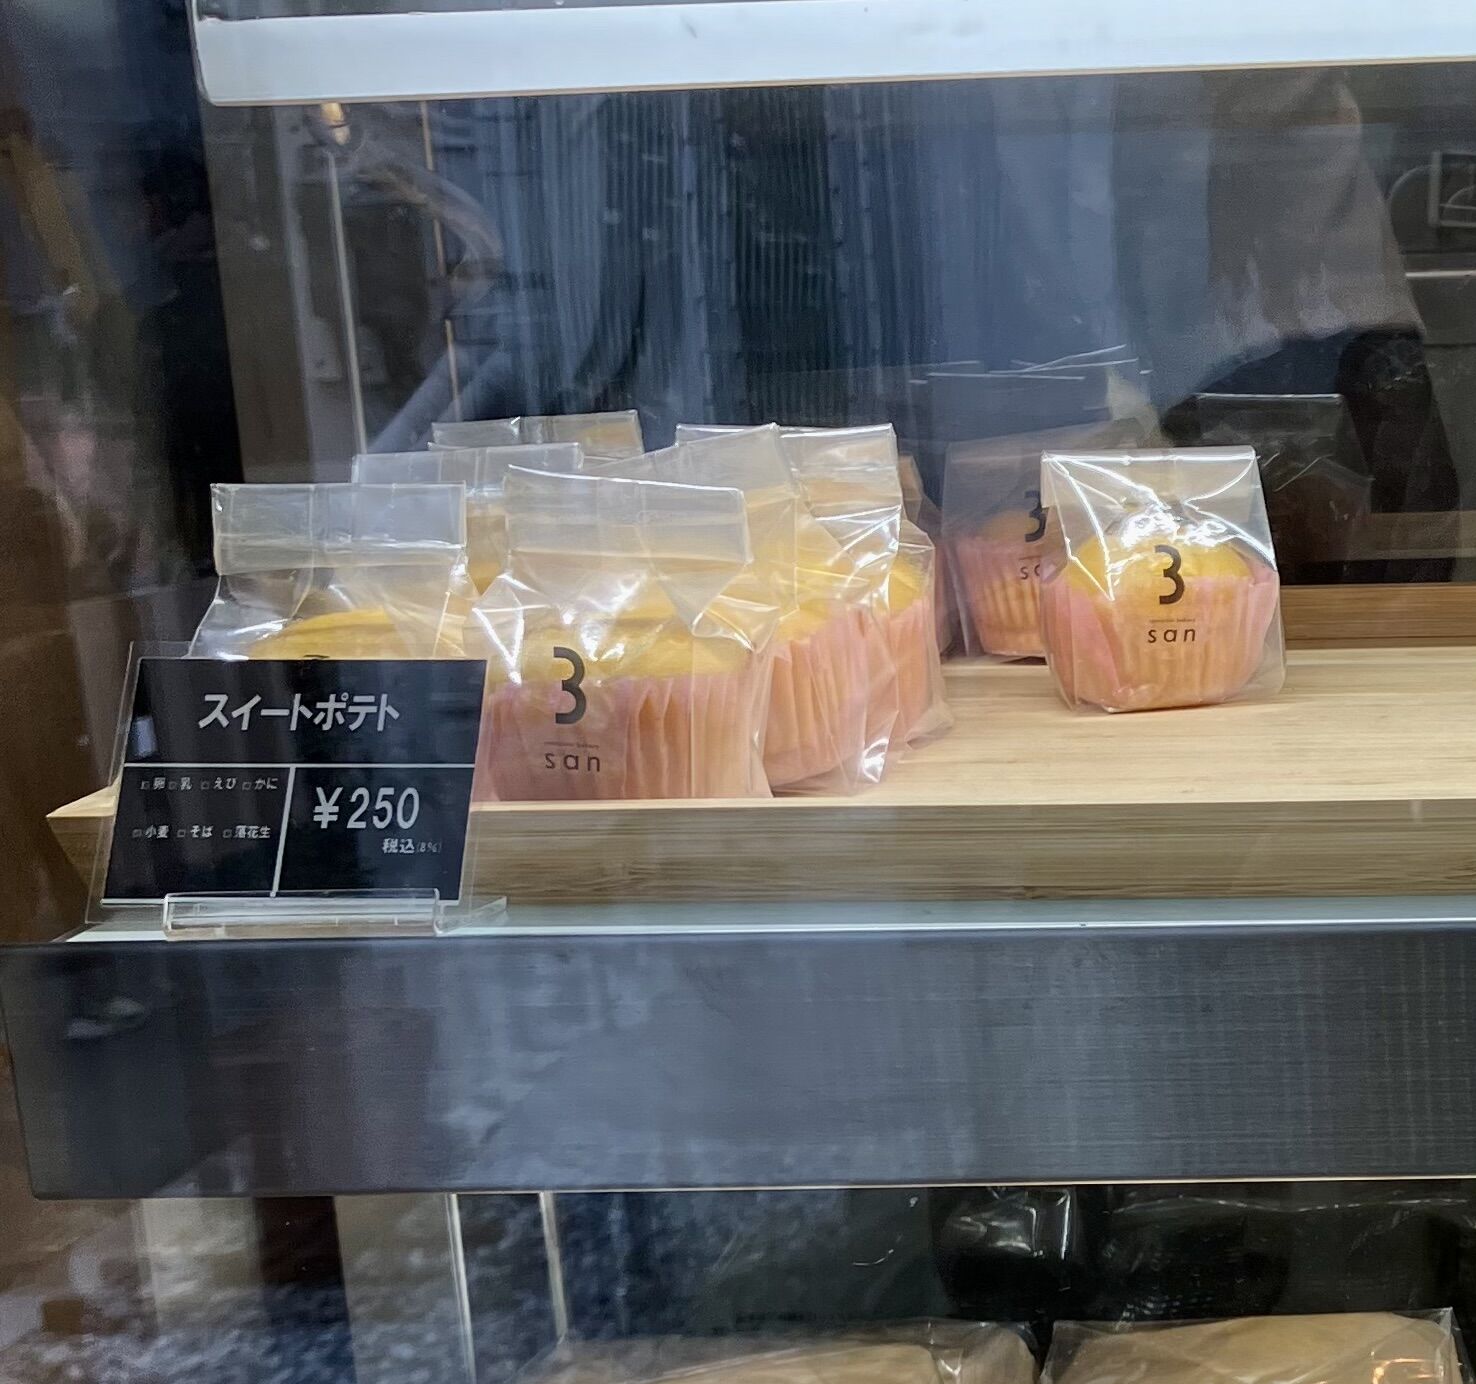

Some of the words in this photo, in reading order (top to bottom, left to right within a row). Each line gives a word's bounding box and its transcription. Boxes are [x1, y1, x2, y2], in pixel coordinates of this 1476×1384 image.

[1155, 545, 1185, 605] 3
[1148, 626, 1196, 644] san
[553, 646, 587, 724] 3
[198, 692, 400, 732] スイートポテト
[544, 751, 601, 773] san
[313, 786, 420, 830] ¥250
